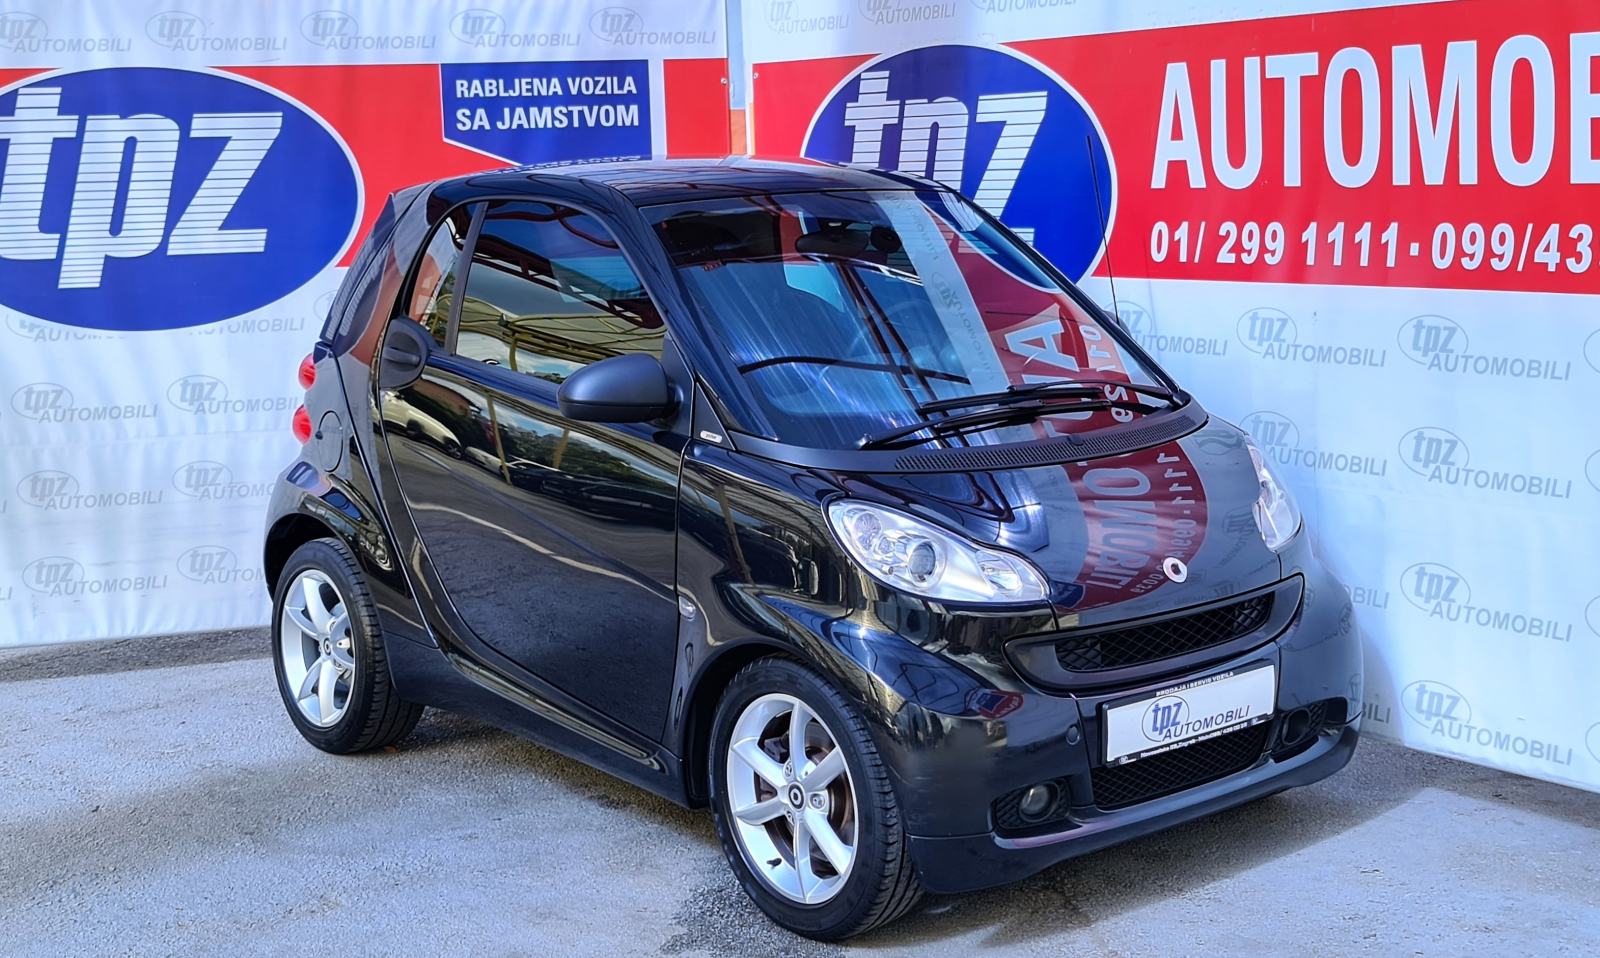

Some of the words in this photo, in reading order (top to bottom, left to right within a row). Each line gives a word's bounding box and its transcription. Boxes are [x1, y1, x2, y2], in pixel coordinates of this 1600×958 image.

[158, 15, 196, 40] tpz
[312, 15, 348, 39] tpz
[460, 12, 496, 37] tpz
[600, 11, 635, 36] tpz
[777, 15, 849, 35] AUTOMOBILI
[875, 3, 956, 25] AUTOMOBILI
[14, 38, 132, 53] AUTOMOBILI
[172, 37, 288, 52] AUTOMOBILI
[325, 35, 436, 50] AUTOMOBILI
[474, 33, 581, 48] AUTOMOBILI
[613, 31, 716, 46] AUTOMOBILI
[456, 77, 562, 98] RABLJENA
[567, 76, 637, 96] VOZILA
[456, 108, 491, 131] SA
[496, 104, 639, 130] JAMSTVOM
[0, 87, 283, 289] tpz
[1151, 221, 1205, 263] 01/
[1217, 221, 1285, 265] 299
[1431, 222, 1600, 274] 099/43
[1248, 311, 1287, 346] tpz
[1412, 319, 1458, 358] tpz
[1133, 334, 1228, 356] UTOMOBILI
[1263, 342, 1386, 368] AUTOMOBILI
[1427, 353, 1572, 382] AUTOMOBILI
[25, 386, 65, 414] tpz
[180, 379, 219, 408] tpz
[39, 404, 158, 423] AUTOMOBILI
[1268, 446, 1388, 477] AUTOMOBILI
[1412, 431, 1459, 468] tpz
[30, 474, 71, 503] tpz
[185, 464, 224, 492] tpz
[1428, 465, 1573, 499] AUTOMOBILI
[45, 490, 163, 511] AUTOMOBILI
[36, 560, 76, 588] tpz
[190, 550, 229, 576] tpz
[50, 575, 168, 597] AUTOMOBILI
[1414, 566, 1460, 604] tpz
[1430, 601, 1573, 642] AUTOMOBILI
[1415, 684, 1461, 721] tpz
[1152, 702, 1183, 736] tpz
[1162, 705, 1250, 742] AUTOMOBILI
[1431, 719, 1573, 766] AUTOMOBILI
